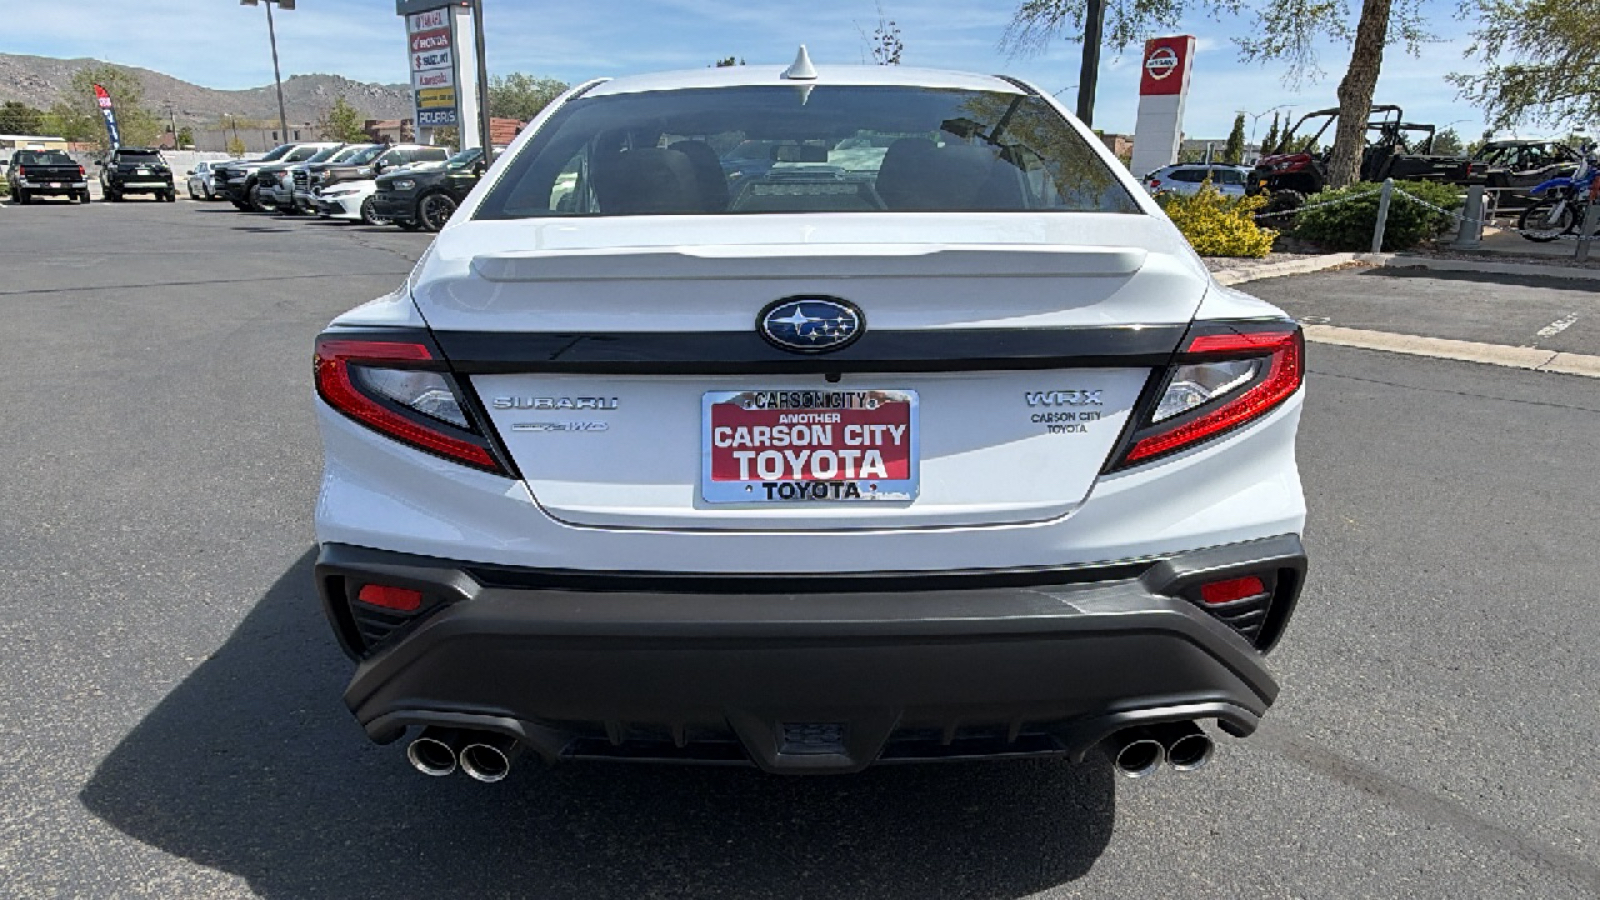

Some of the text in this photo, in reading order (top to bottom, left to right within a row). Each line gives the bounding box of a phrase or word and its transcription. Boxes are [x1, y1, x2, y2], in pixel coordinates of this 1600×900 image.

[419, 35, 448, 48] HONDA
[419, 110, 456, 123] POLARIS
[492, 396, 619, 410] SUBARU
[754, 391, 867, 409] CARSON CITY
[1025, 389, 1103, 407] WRX
[778, 413, 841, 424] ANOTHER
[1030, 410, 1102, 423] CARSON CITY
[714, 424, 908, 447] CARSON CITY
[1047, 423, 1088, 434] TOYOTA
[733, 449, 888, 481] TOYOTA
[762, 482, 861, 500] TOYOTA
